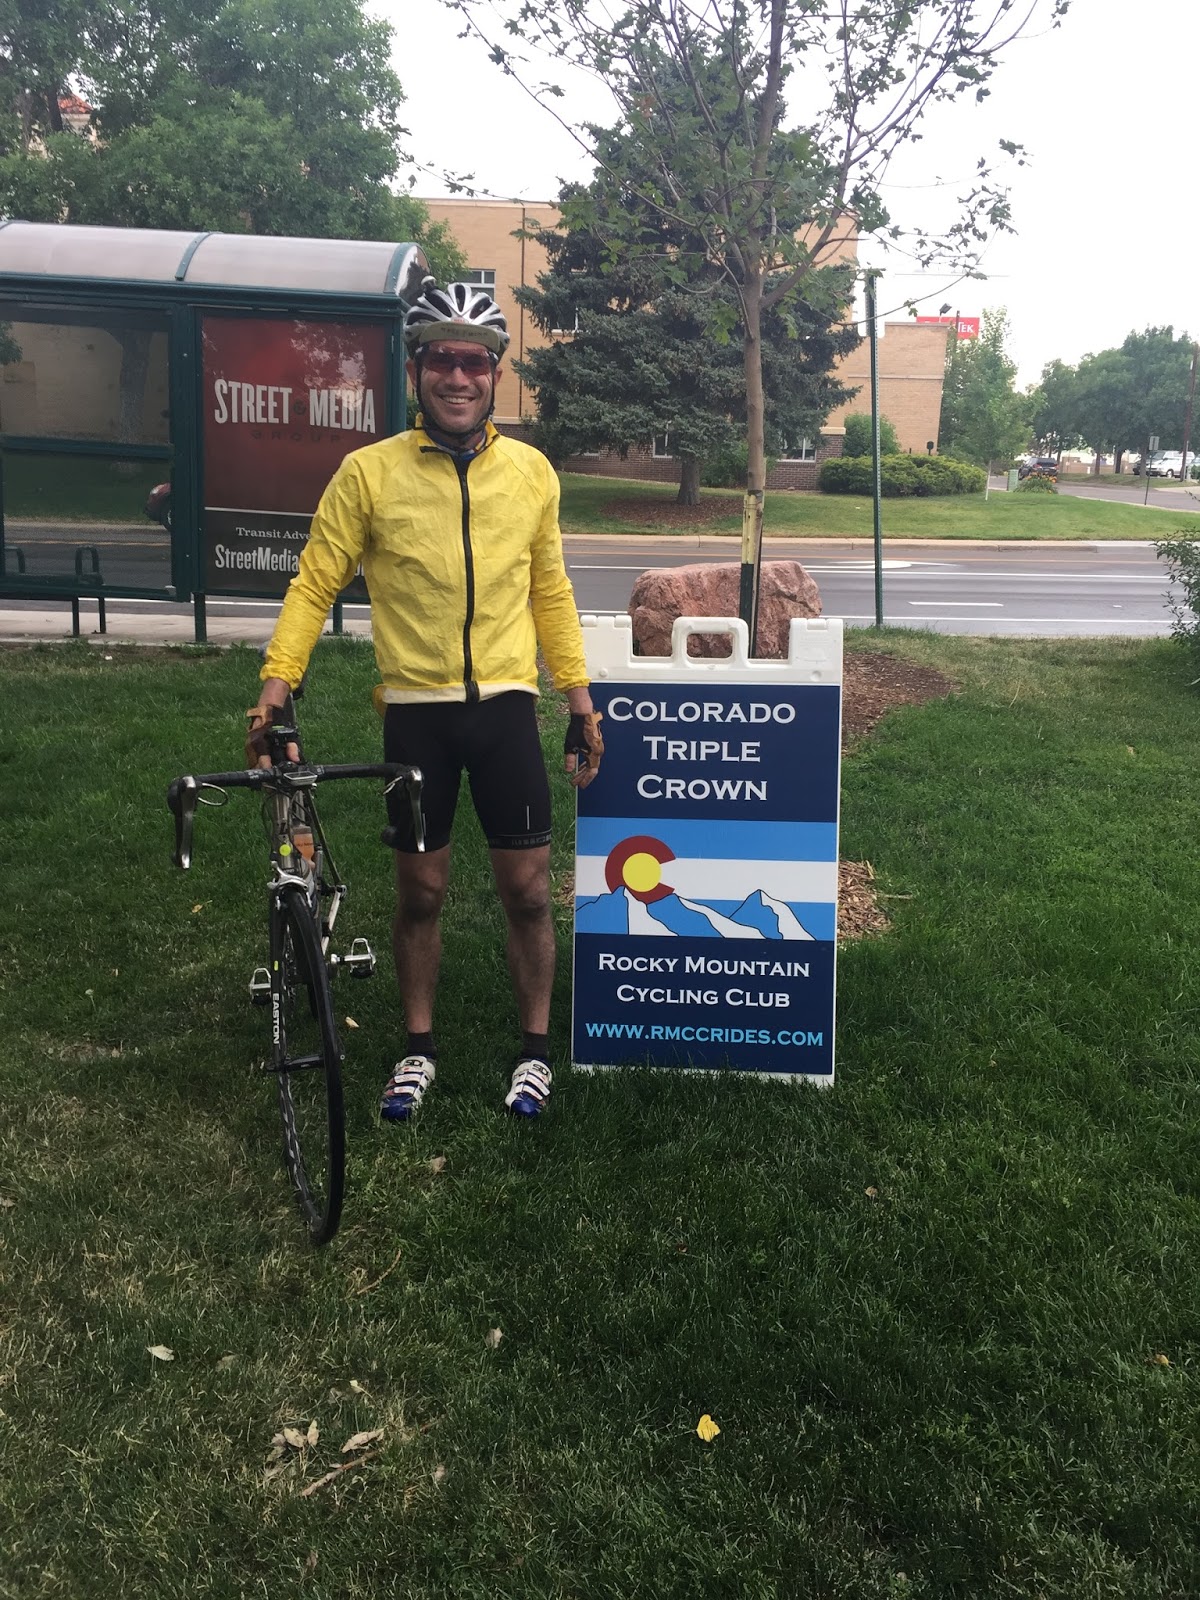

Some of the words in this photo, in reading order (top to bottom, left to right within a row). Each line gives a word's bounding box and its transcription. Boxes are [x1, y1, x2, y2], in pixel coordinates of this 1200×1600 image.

[214, 378, 292, 424] STREET
[309, 388, 376, 434] MEDIA
[235, 526, 282, 539] Transit
[607, 696, 796, 724] COLORADO
[643, 735, 761, 762] TRIPLE
[637, 774, 768, 801] CROWN
[598, 953, 678, 973] ROCKY
[684, 955, 810, 978] MOUNTAIN
[616, 984, 719, 1005] CYCLING
[725, 988, 790, 1008] CLUB
[272, 992, 280, 1045] EASTON
[585, 1022, 824, 1047] WWW.RMCCRIDES.COM
